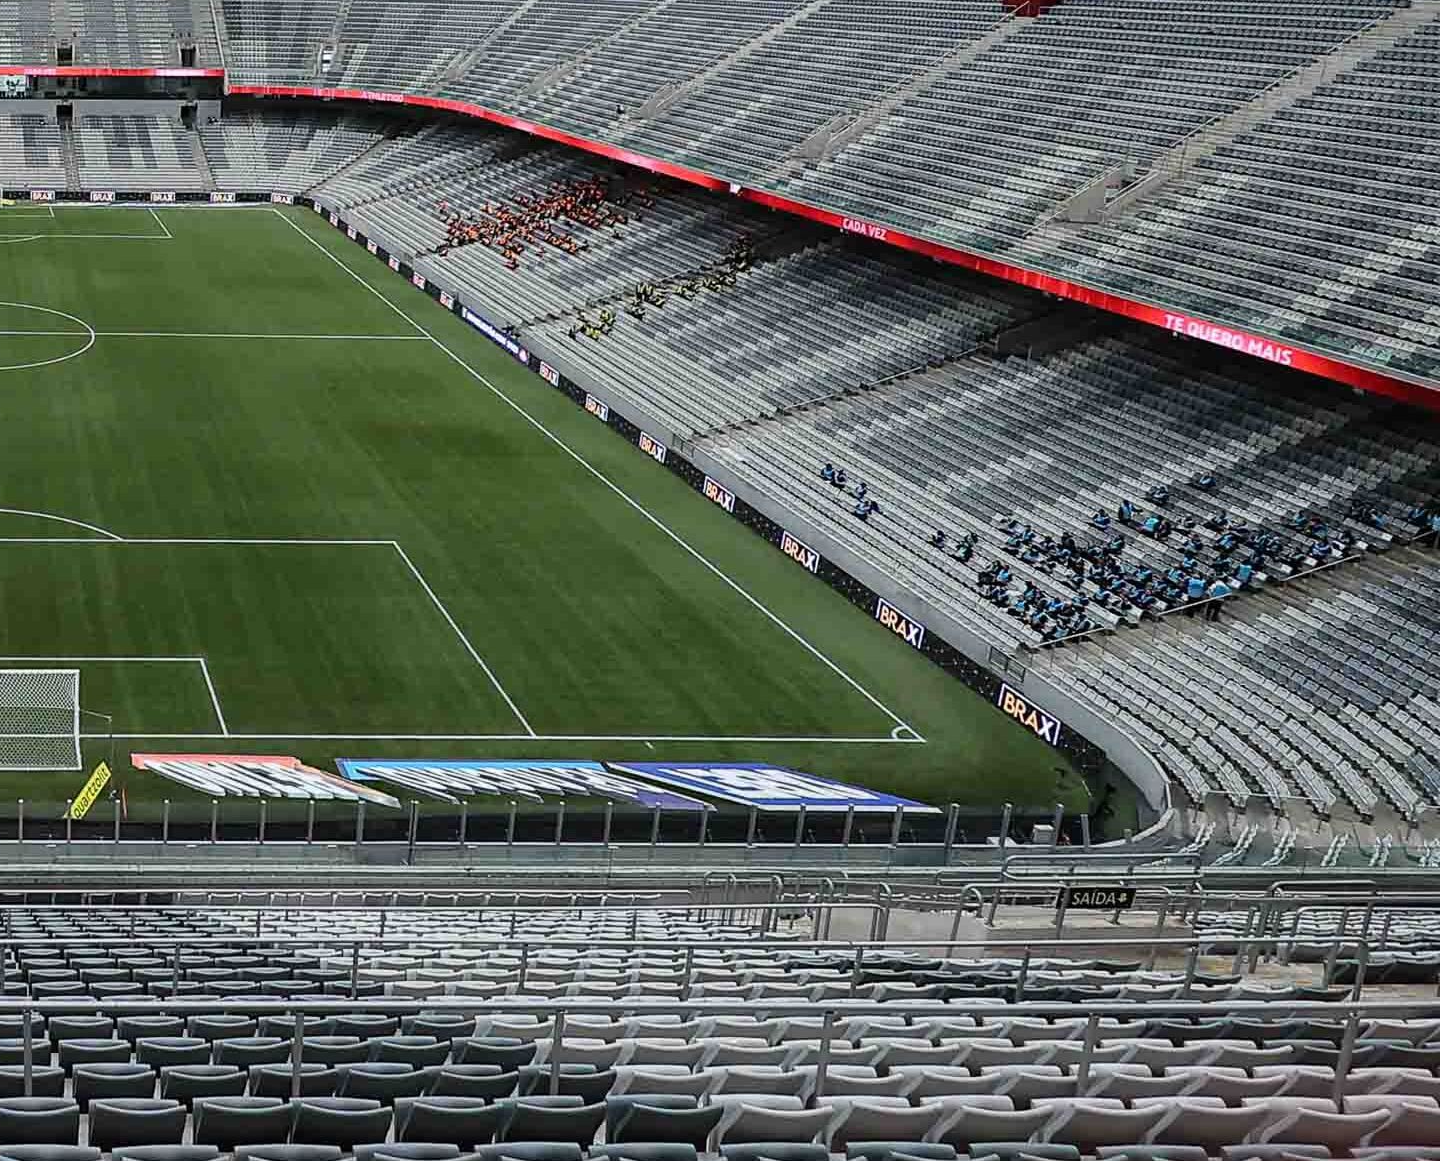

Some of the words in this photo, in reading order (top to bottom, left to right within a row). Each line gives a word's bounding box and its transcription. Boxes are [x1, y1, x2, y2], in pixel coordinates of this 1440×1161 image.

[843, 218, 868, 234] CADA
[868, 225, 887, 240] VEZ
[1163, 314, 1184, 332] TE
[1187, 321, 1243, 350] QUERO
[1247, 340, 1293, 365] MAIS
[586, 398, 607, 421] BRAX
[641, 436, 664, 463] BRAX
[706, 482, 734, 512] BRAX
[783, 537, 817, 572] BRAX
[879, 604, 920, 647] BRAX
[1003, 692, 1058, 743] BRAX
[73, 767, 109, 818] quartzolit
[1071, 888, 1116, 907] SAÍDA
